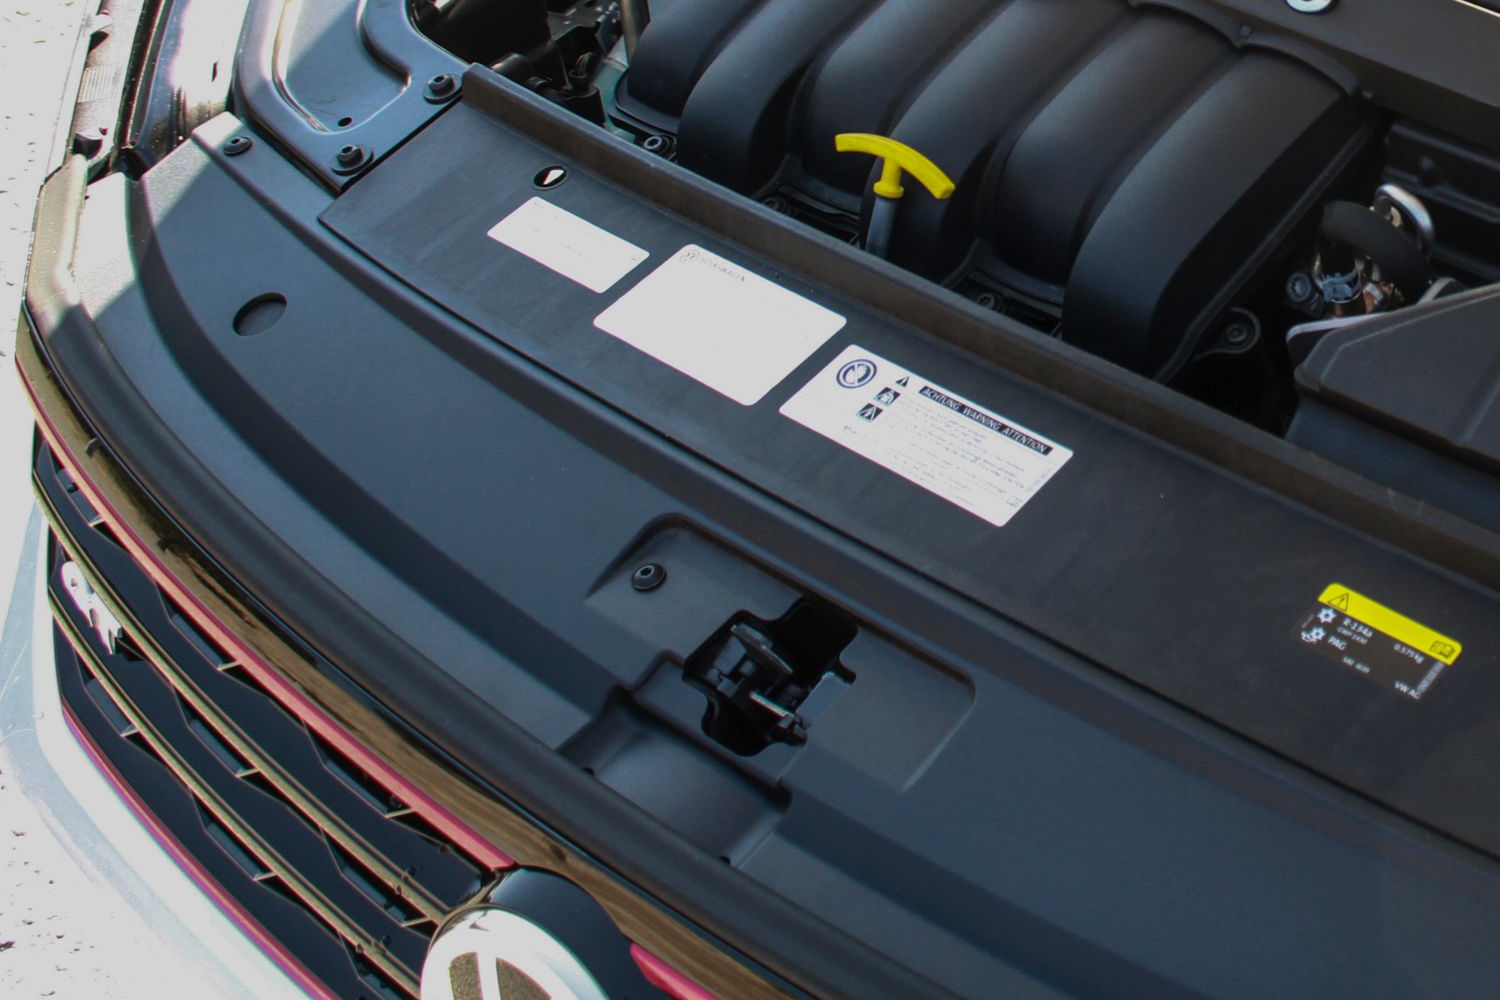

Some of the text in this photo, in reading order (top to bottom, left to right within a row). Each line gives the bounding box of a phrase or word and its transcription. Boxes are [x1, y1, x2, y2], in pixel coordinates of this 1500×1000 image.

[922, 388, 961, 411] ACHTUNG
[962, 407, 1001, 432] WARNING
[1002, 427, 1048, 453] ATTENTION
[1328, 636, 1347, 650] PAG
